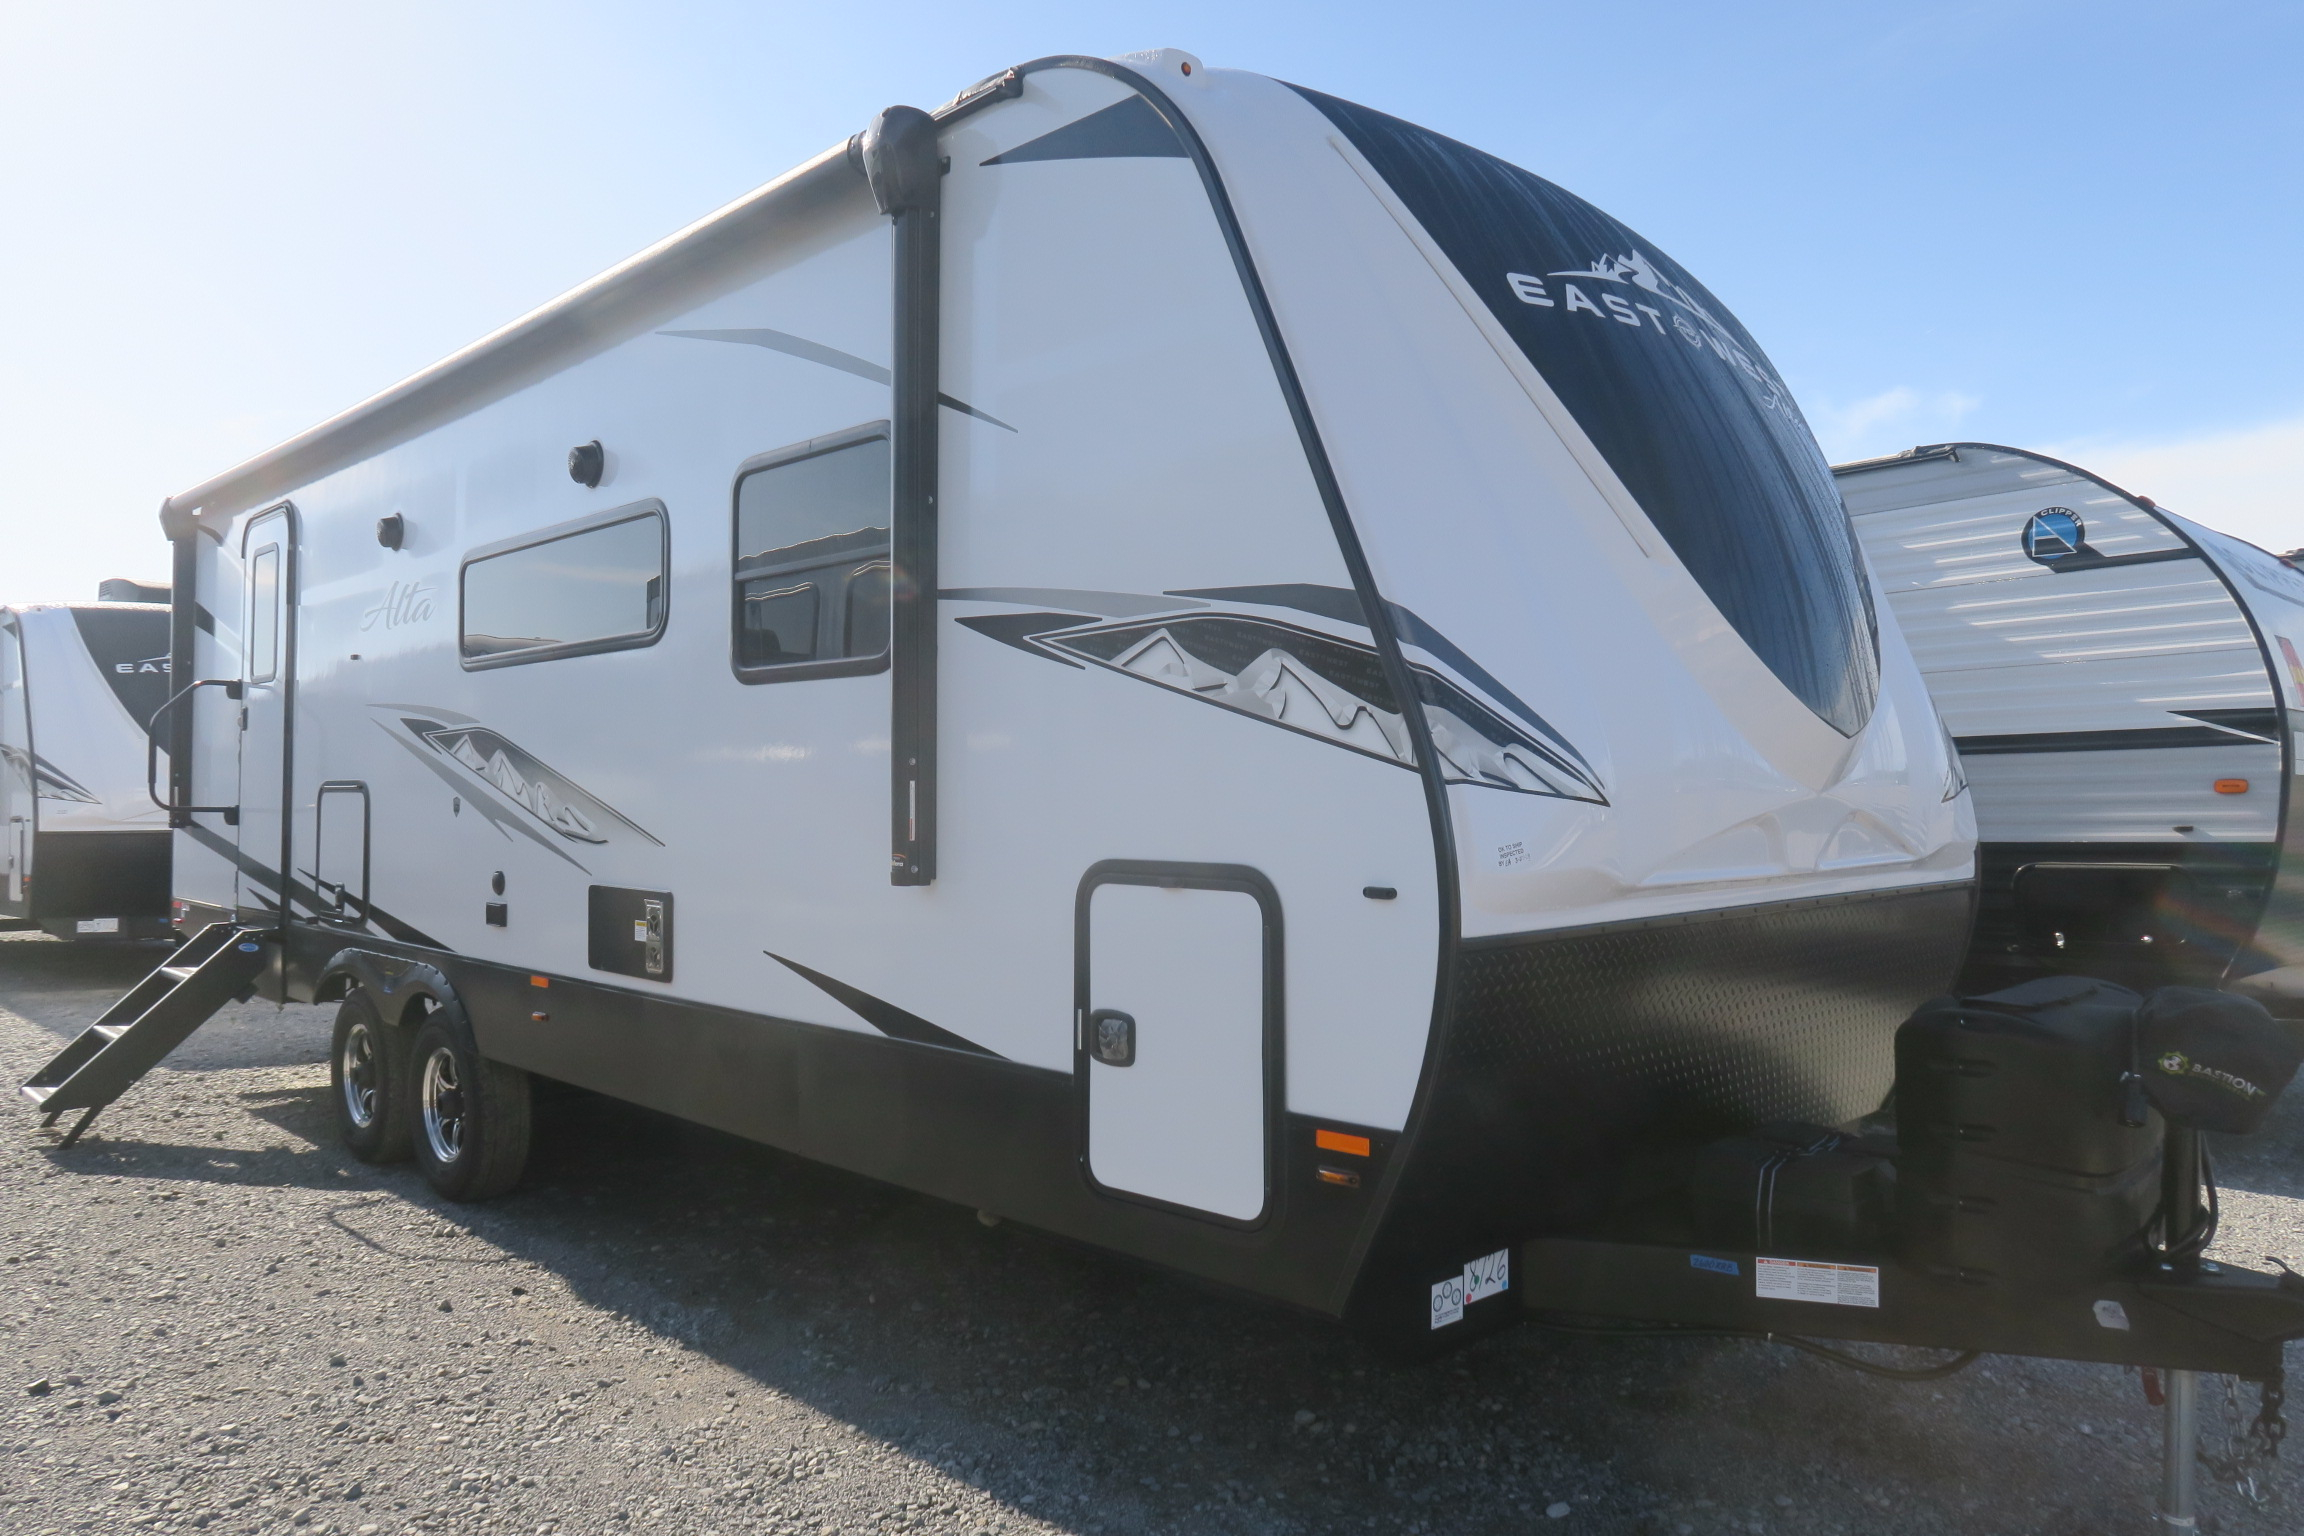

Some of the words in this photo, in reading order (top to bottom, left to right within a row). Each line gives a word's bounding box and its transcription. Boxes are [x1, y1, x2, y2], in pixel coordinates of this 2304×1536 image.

[2041, 508, 2082, 527] CLIPPER
[360, 580, 437, 632] Alta
[2191, 1063, 2256, 1096] BASTION
